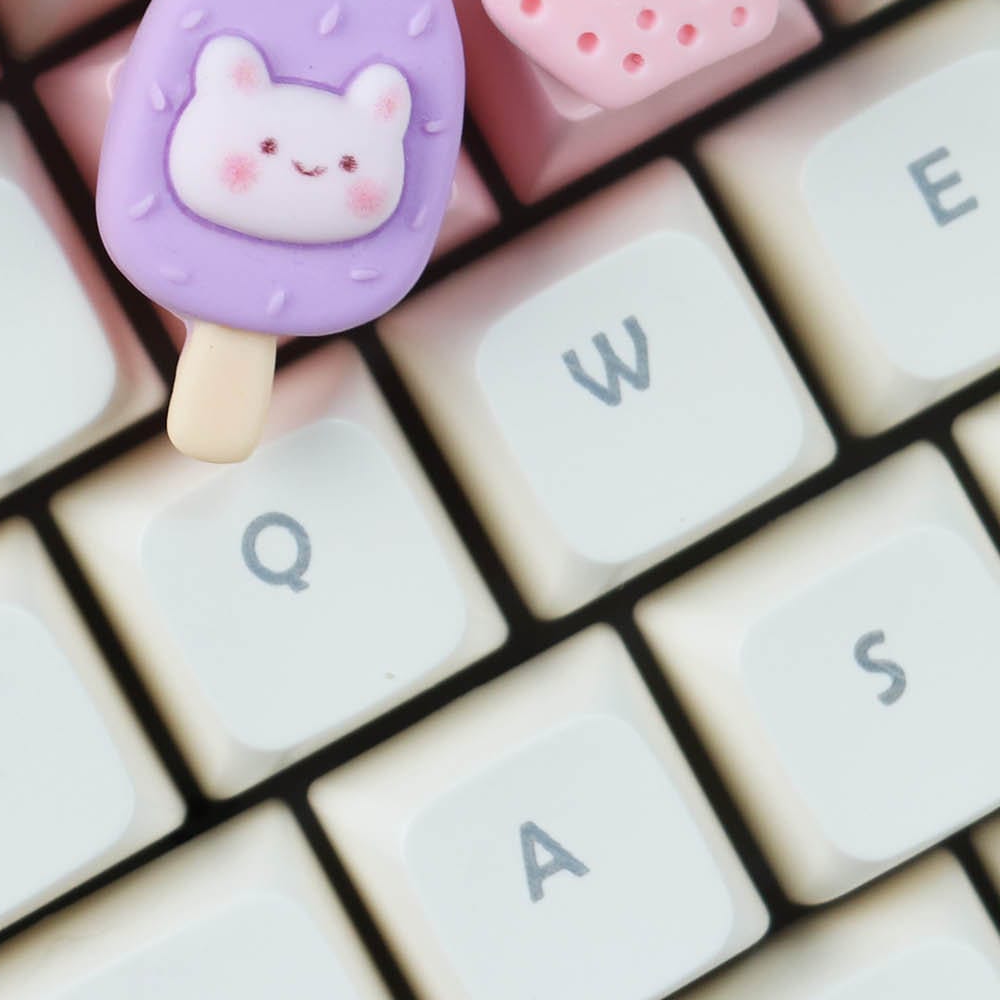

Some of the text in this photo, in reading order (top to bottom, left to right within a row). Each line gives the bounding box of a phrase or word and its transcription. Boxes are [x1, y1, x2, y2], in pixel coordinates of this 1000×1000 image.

[906, 145, 979, 228] E
[561, 314, 651, 407] W
[240, 511, 312, 594] Q
[853, 629, 908, 707] S
[518, 820, 591, 904] A
